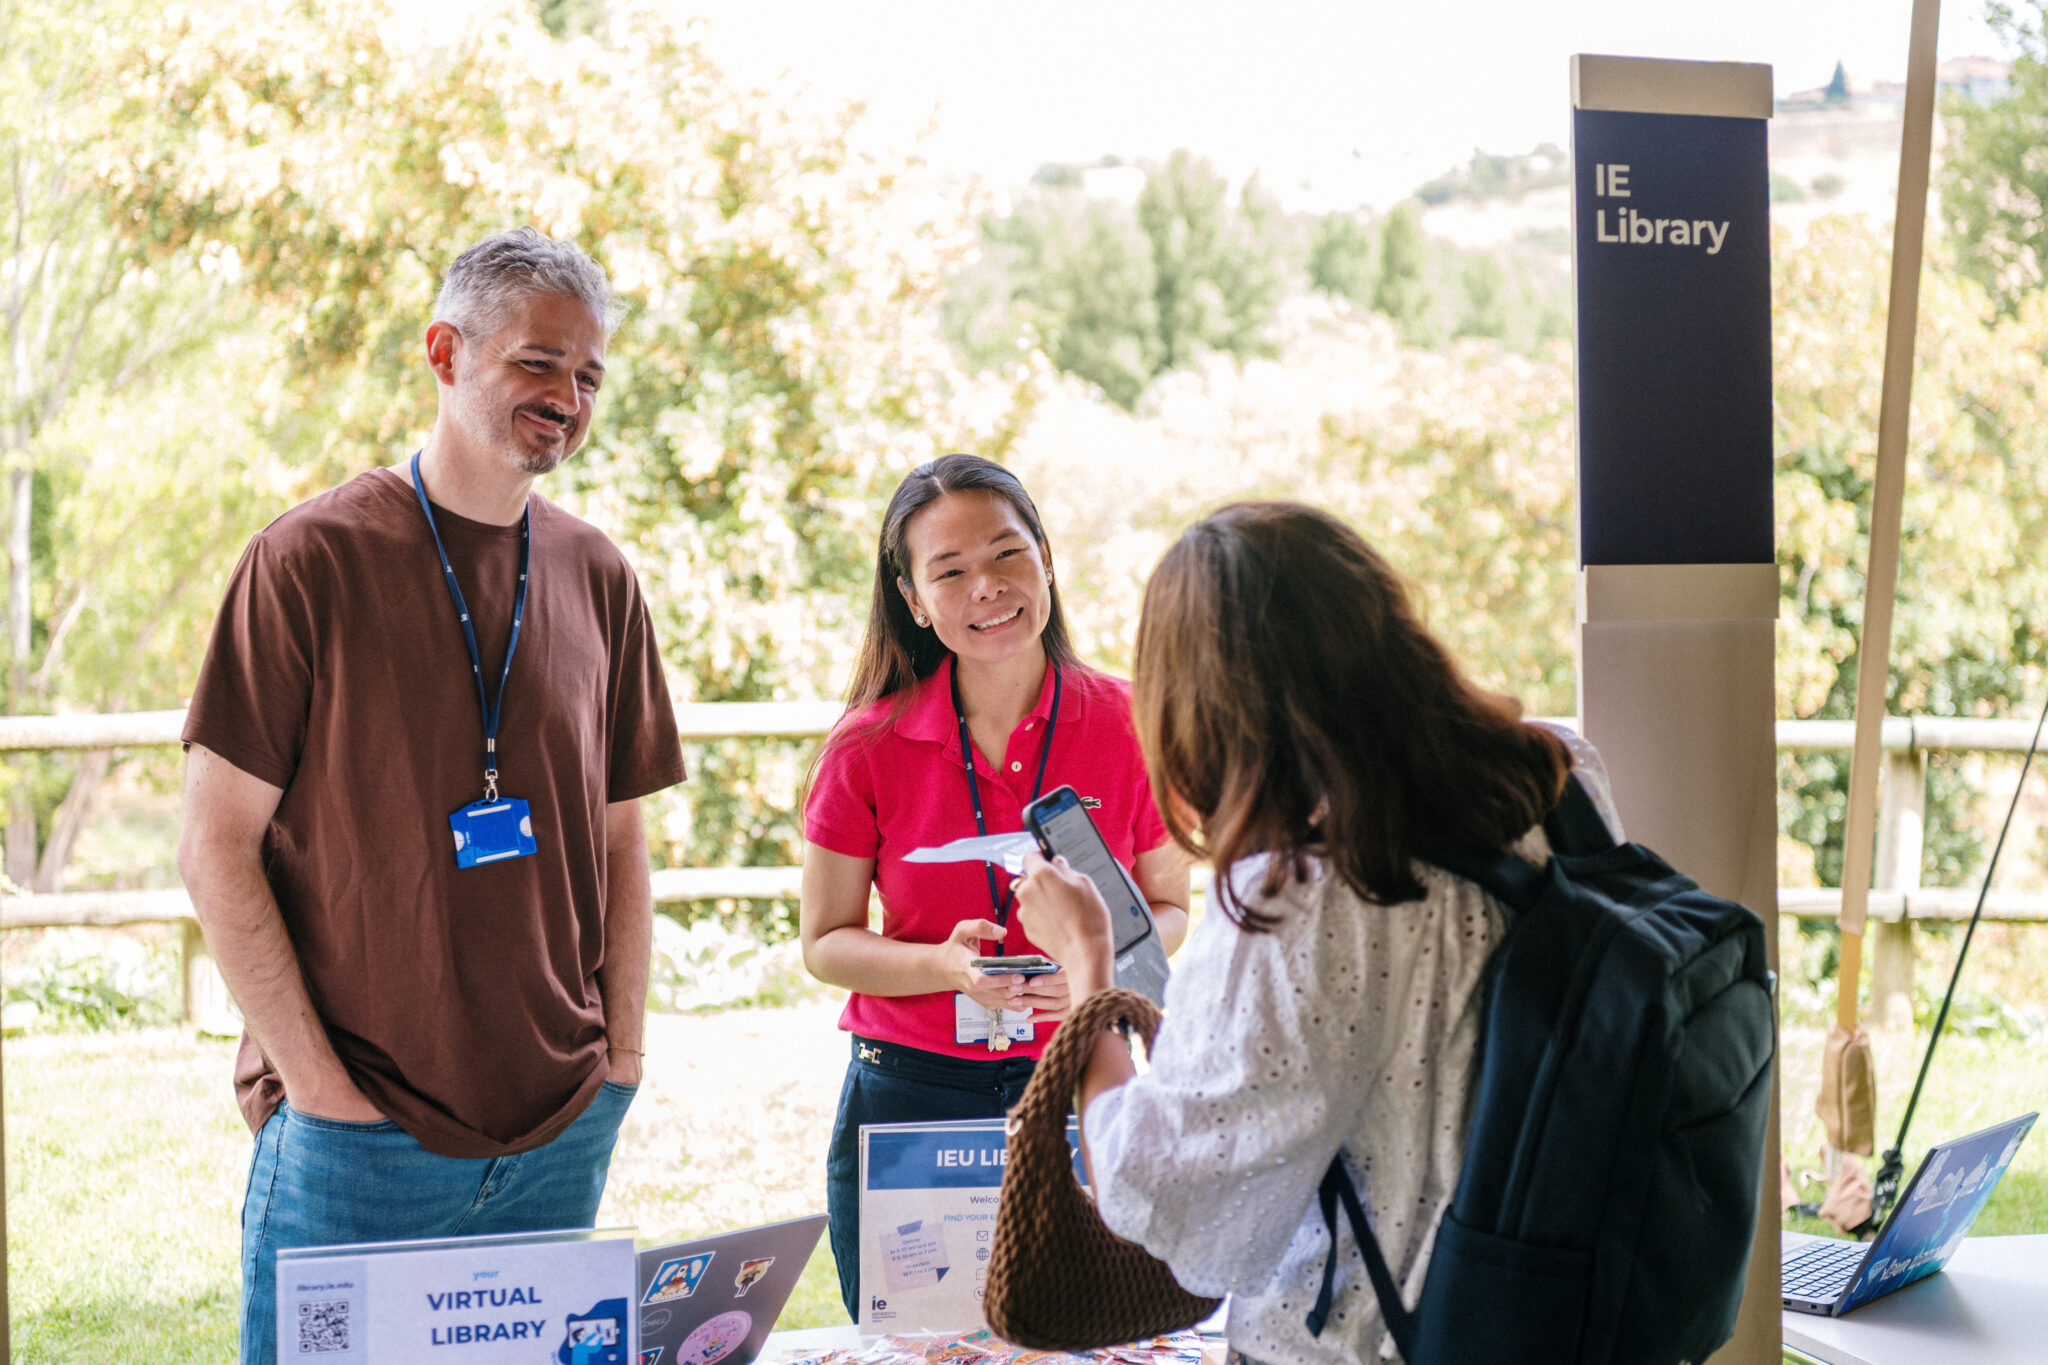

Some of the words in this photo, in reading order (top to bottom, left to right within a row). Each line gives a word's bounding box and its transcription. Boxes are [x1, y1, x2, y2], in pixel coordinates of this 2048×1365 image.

[1596, 163, 1631, 197] IE
[1597, 207, 1730, 254] Library
[1016, 1026, 1026, 1035] ie
[936, 1149, 975, 1167] IEU
[943, 1214, 963, 1222] FIND
[473, 1269, 499, 1281] your
[426, 1286, 543, 1311] VIRTUAL
[872, 1295, 887, 1310] ie
[431, 1319, 547, 1346] LIBRARY
